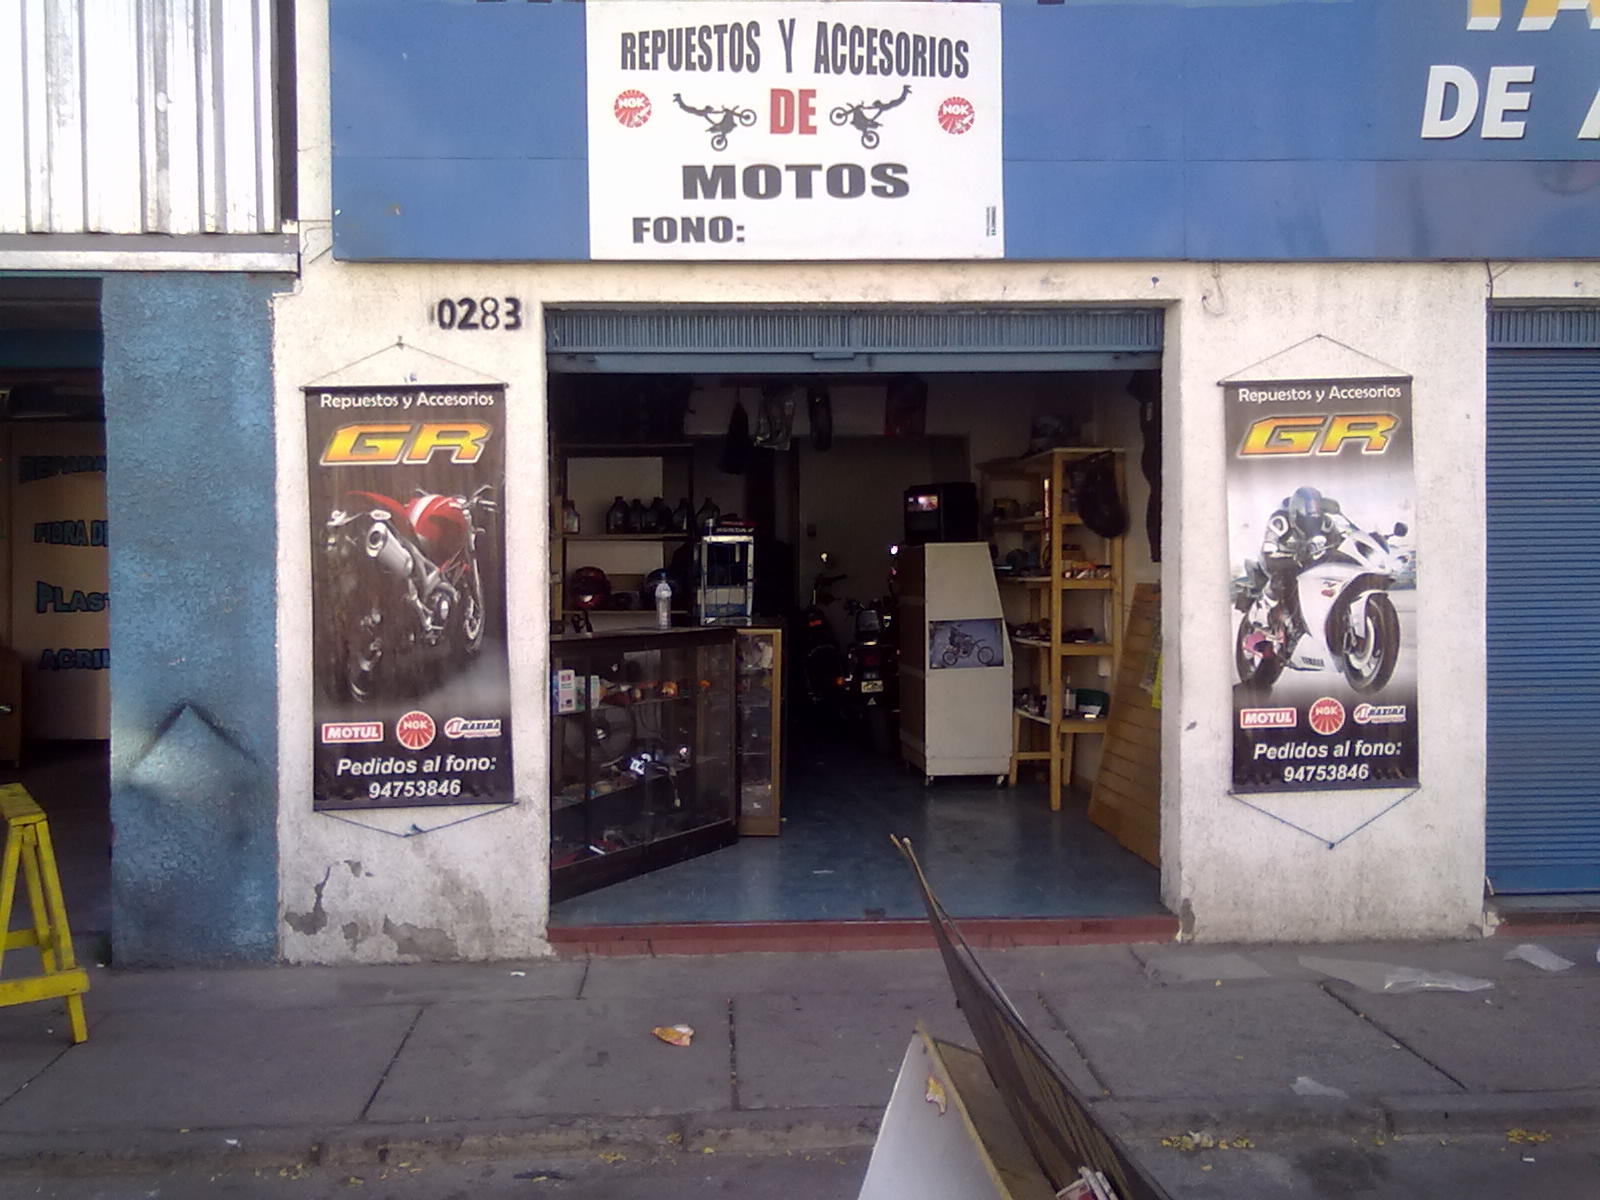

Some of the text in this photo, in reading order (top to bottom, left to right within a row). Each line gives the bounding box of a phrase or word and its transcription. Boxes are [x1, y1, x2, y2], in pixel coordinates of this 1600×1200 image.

[621, 18, 970, 79] REPUESTOS Y ACCESORIOS
[618, 97, 647, 110] NGK
[769, 88, 818, 136] DE
[942, 103, 970, 116] NGK
[1420, 65, 1536, 140] DE
[682, 163, 910, 200] MOTOS
[632, 216, 745, 244] FONO:
[437, 297, 522, 331] 0283
[320, 391, 495, 410] Repuestos y Accesorios
[1238, 385, 1402, 404] Repuestos y Accesorios
[319, 420, 492, 466] GR
[1237, 412, 1400, 458] GR
[1244, 711, 1293, 724] MOTUL
[1315, 707, 1338, 716] NGK
[327, 725, 379, 739] MOTUL
[403, 720, 428, 730] NGK
[1253, 740, 1402, 760] Pedidos al fono:
[336, 754, 497, 776] Pedidos al fono:
[1283, 764, 1369, 782] 94753846
[369, 779, 462, 799] 94753846
